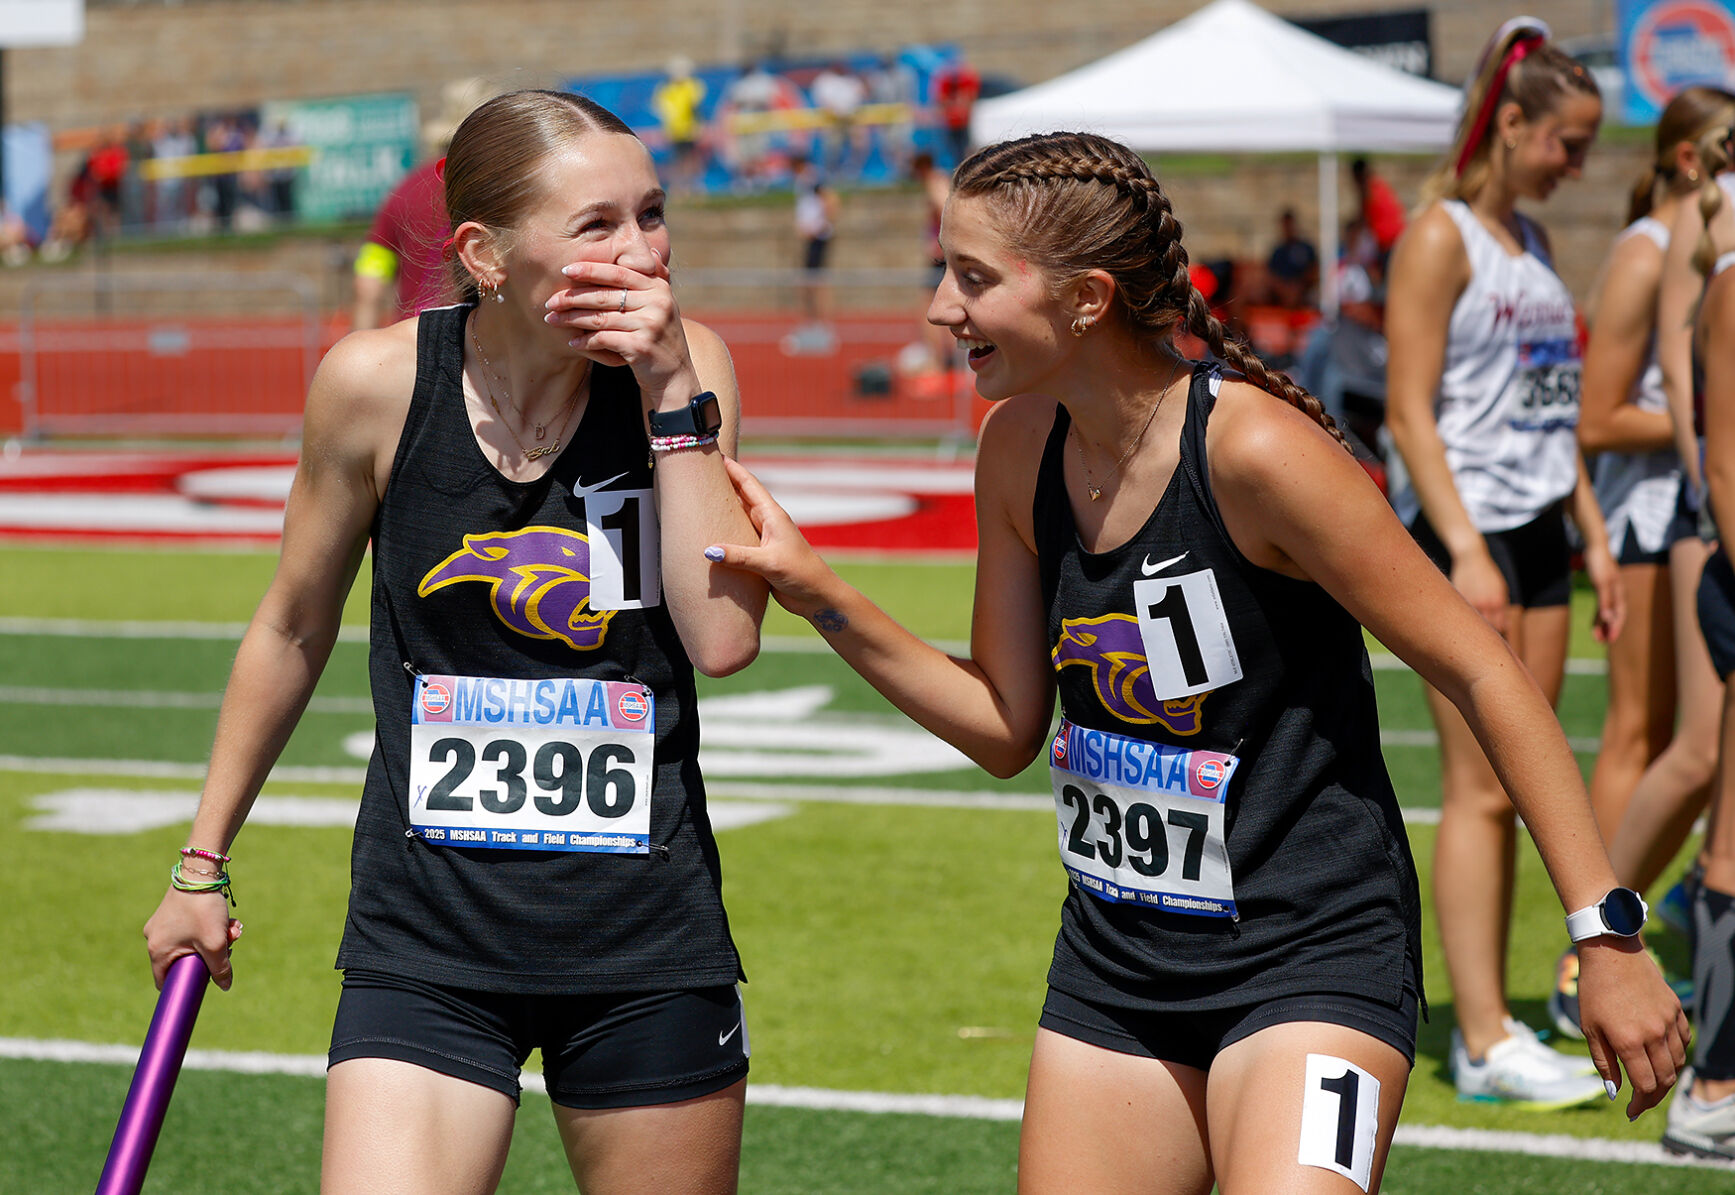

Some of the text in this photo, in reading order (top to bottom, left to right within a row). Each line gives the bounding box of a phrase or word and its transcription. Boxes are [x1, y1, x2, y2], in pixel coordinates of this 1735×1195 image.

[600, 497, 641, 601] 1
[1148, 584, 1210, 687] 1
[455, 678, 608, 727] MSHSAA
[426, 737, 636, 818] 2396
[1069, 726, 1187, 793] MSHSAA
[424, 828, 636, 848] 2025 MSHSAA Track and Field Championships
[1062, 784, 1209, 882] 2397
[1162, 895, 1223, 912] Championships
[1320, 1069, 1359, 1171] 1
